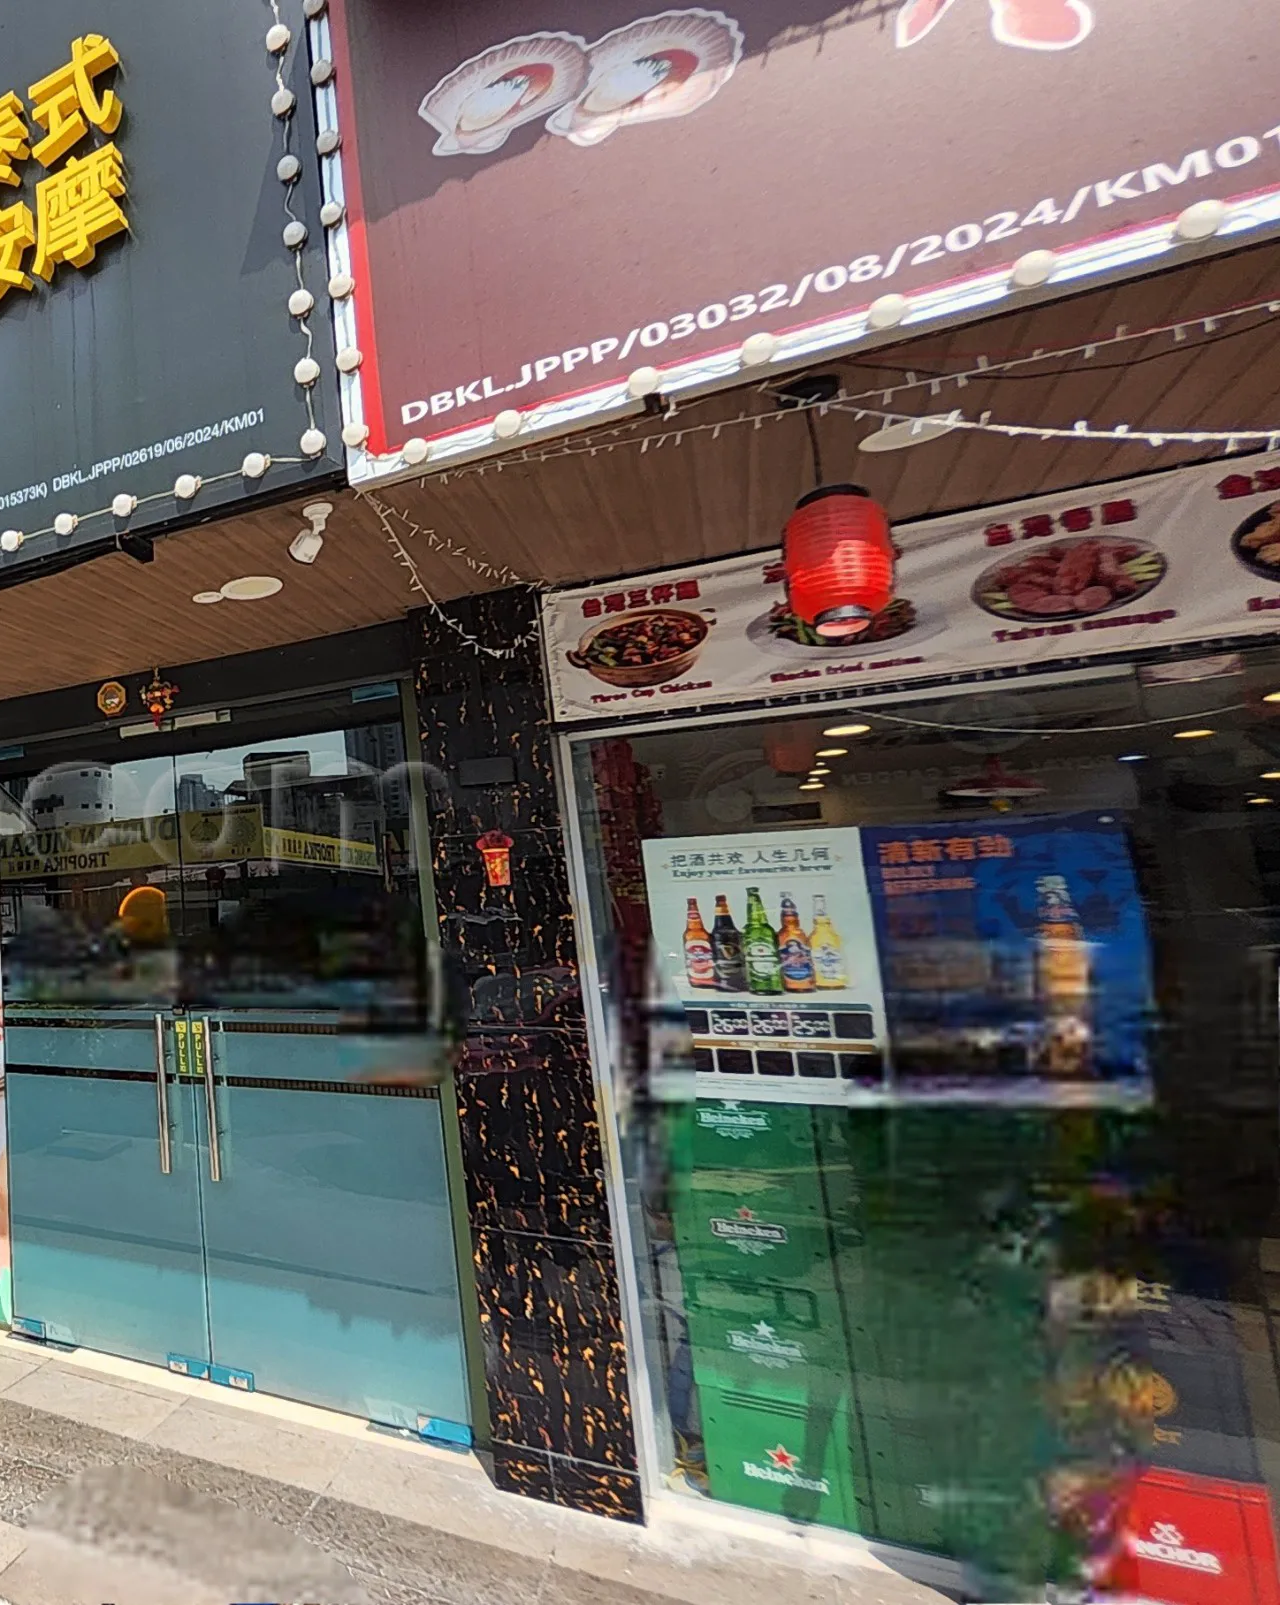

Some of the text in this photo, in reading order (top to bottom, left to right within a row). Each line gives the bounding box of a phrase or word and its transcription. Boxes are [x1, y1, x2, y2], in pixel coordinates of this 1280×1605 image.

[178, 1033, 186, 1065] PULL
[742, 1460, 831, 1495] Heineken
[1134, 1539, 1223, 1574] NCHOR
